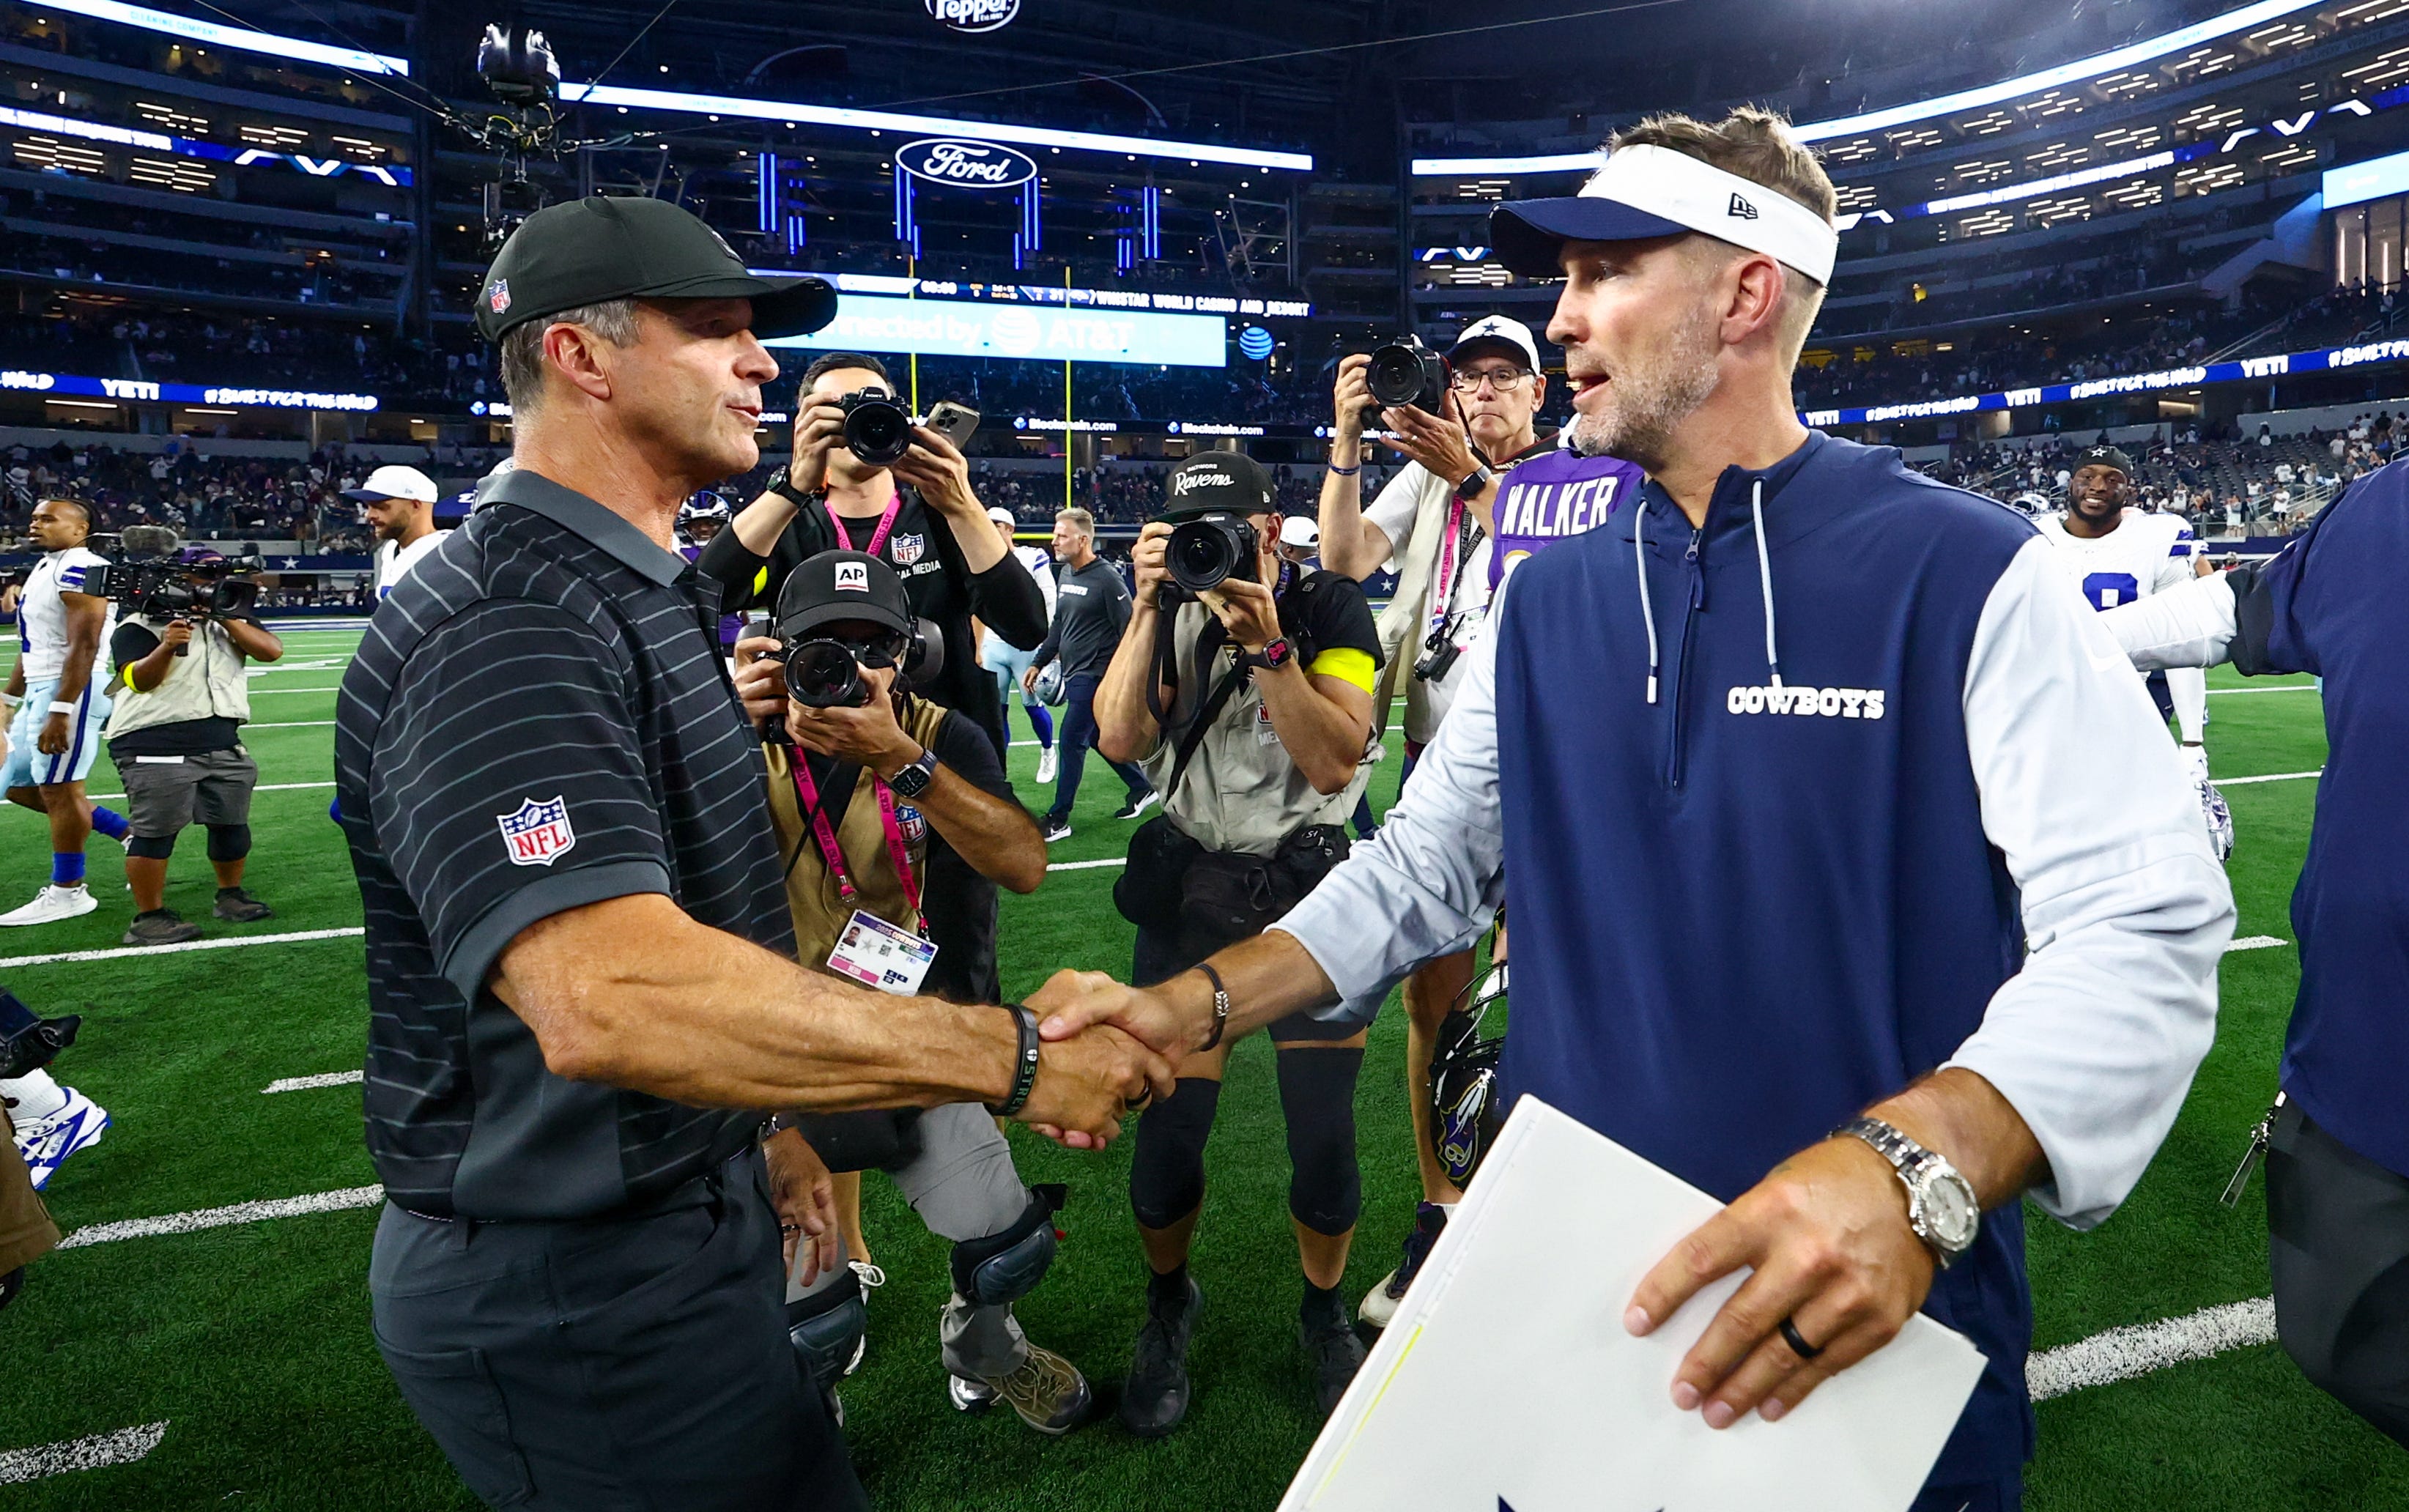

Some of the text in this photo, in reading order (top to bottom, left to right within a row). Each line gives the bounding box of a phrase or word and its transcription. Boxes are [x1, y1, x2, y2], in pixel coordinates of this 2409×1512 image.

[923, 144, 1011, 182] Ford
[947, 314, 983, 348] by
[1046, 318, 1135, 351] AT&T
[2240, 355, 2289, 378] YETI
[100, 378, 160, 400] YETI
[2004, 387, 2042, 407] YETI
[1805, 410, 1840, 426] YETI
[1174, 472, 1235, 496] Ravens
[1501, 476, 1618, 536] WALKER
[896, 546, 920, 561] NFL
[839, 568, 864, 580] AP
[912, 560, 942, 575] MEDIA
[1727, 686, 1885, 720] COWBOYS
[513, 824, 568, 857] NFL
[898, 819, 923, 841] NFL
[875, 924, 892, 937] 2025
